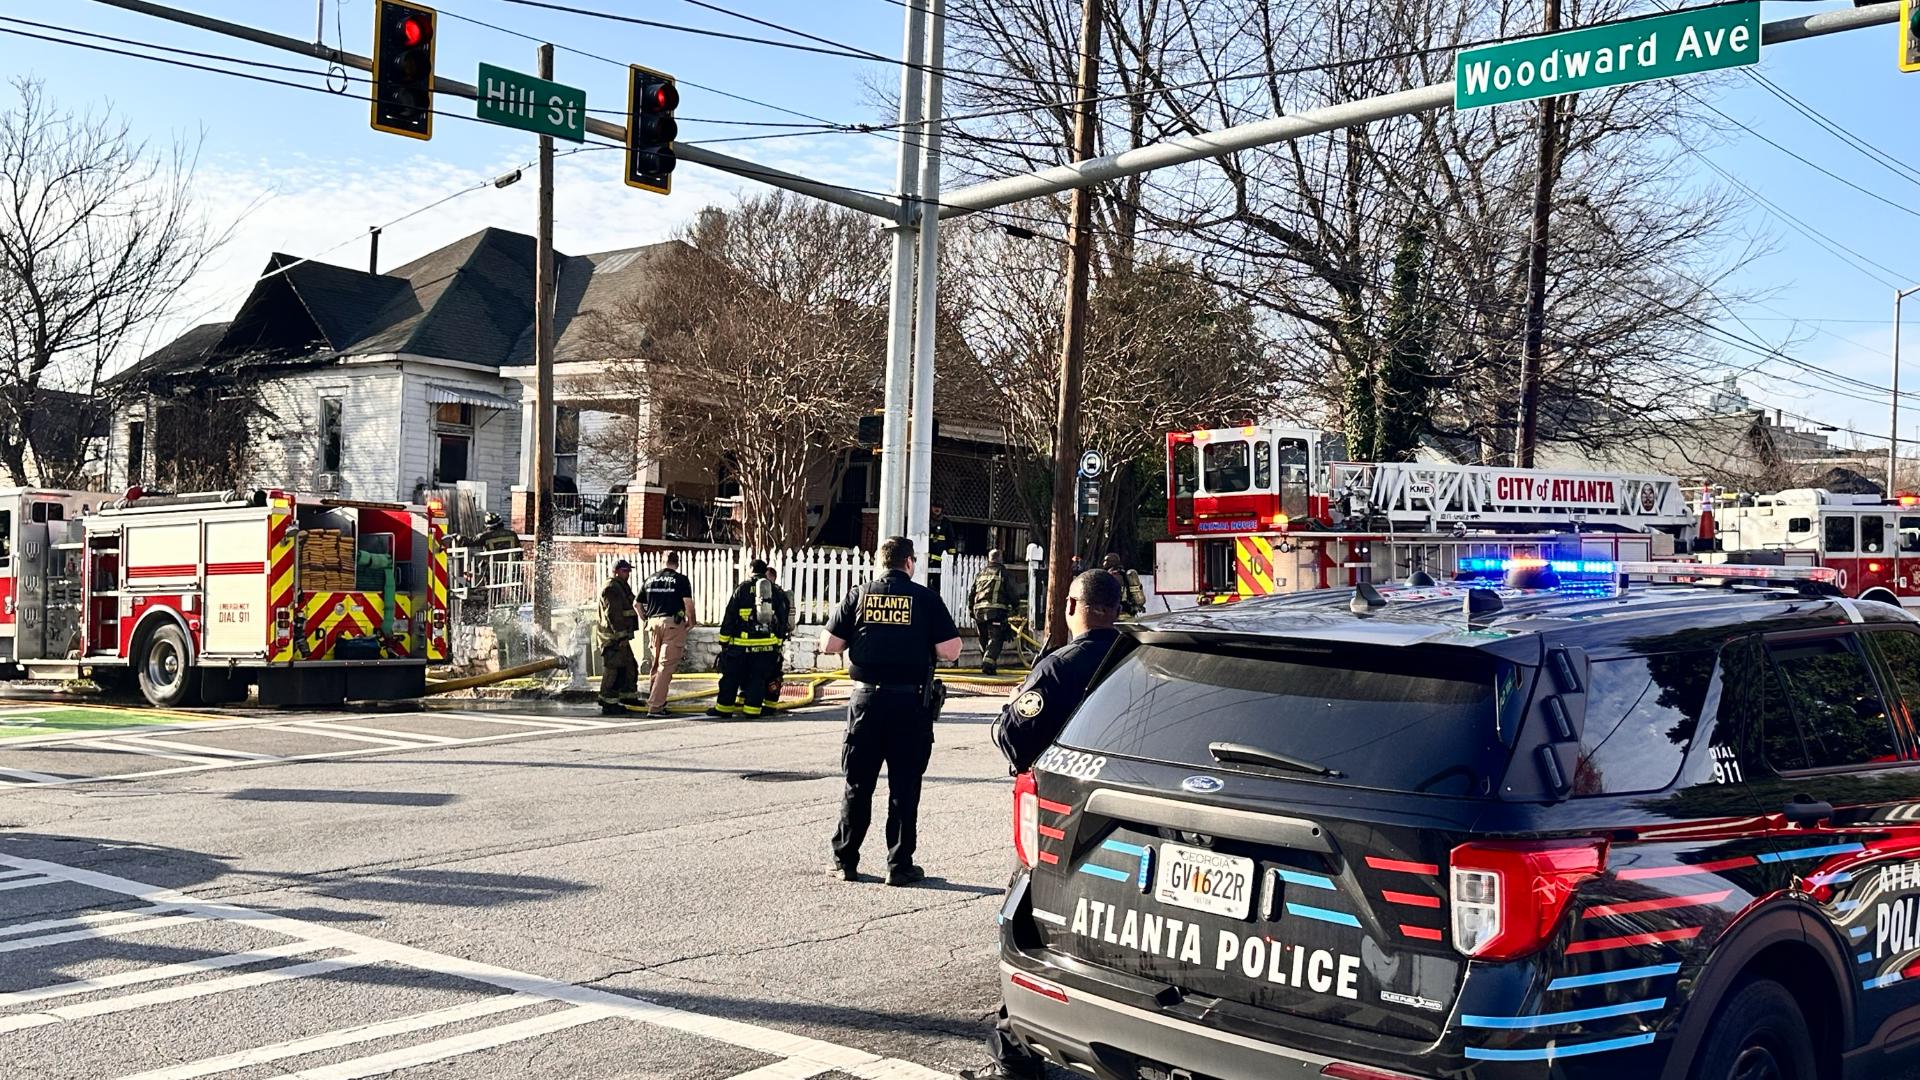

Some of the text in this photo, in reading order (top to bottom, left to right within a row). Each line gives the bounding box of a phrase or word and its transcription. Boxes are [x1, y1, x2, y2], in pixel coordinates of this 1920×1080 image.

[1464, 24, 1750, 96] Woodward Ave
[486, 77, 577, 130] Hill St
[1409, 485, 1430, 494] KME
[1497, 476, 1615, 503] CITY of ATLANTA
[1231, 519, 1258, 531] HOUSE
[1248, 555, 1264, 576] 10
[866, 596, 910, 609] ATLANTA
[219, 611, 250, 623] DIAL 911
[865, 609, 910, 623] POLICE
[1039, 744, 1107, 781] 35388
[1708, 746, 1735, 760] DIAL
[1713, 760, 1743, 784] 911
[1180, 850, 1231, 870] GEORGIA
[1171, 860, 1246, 903] GV1622R
[1071, 897, 1361, 1000] ATLANTA POLICE
